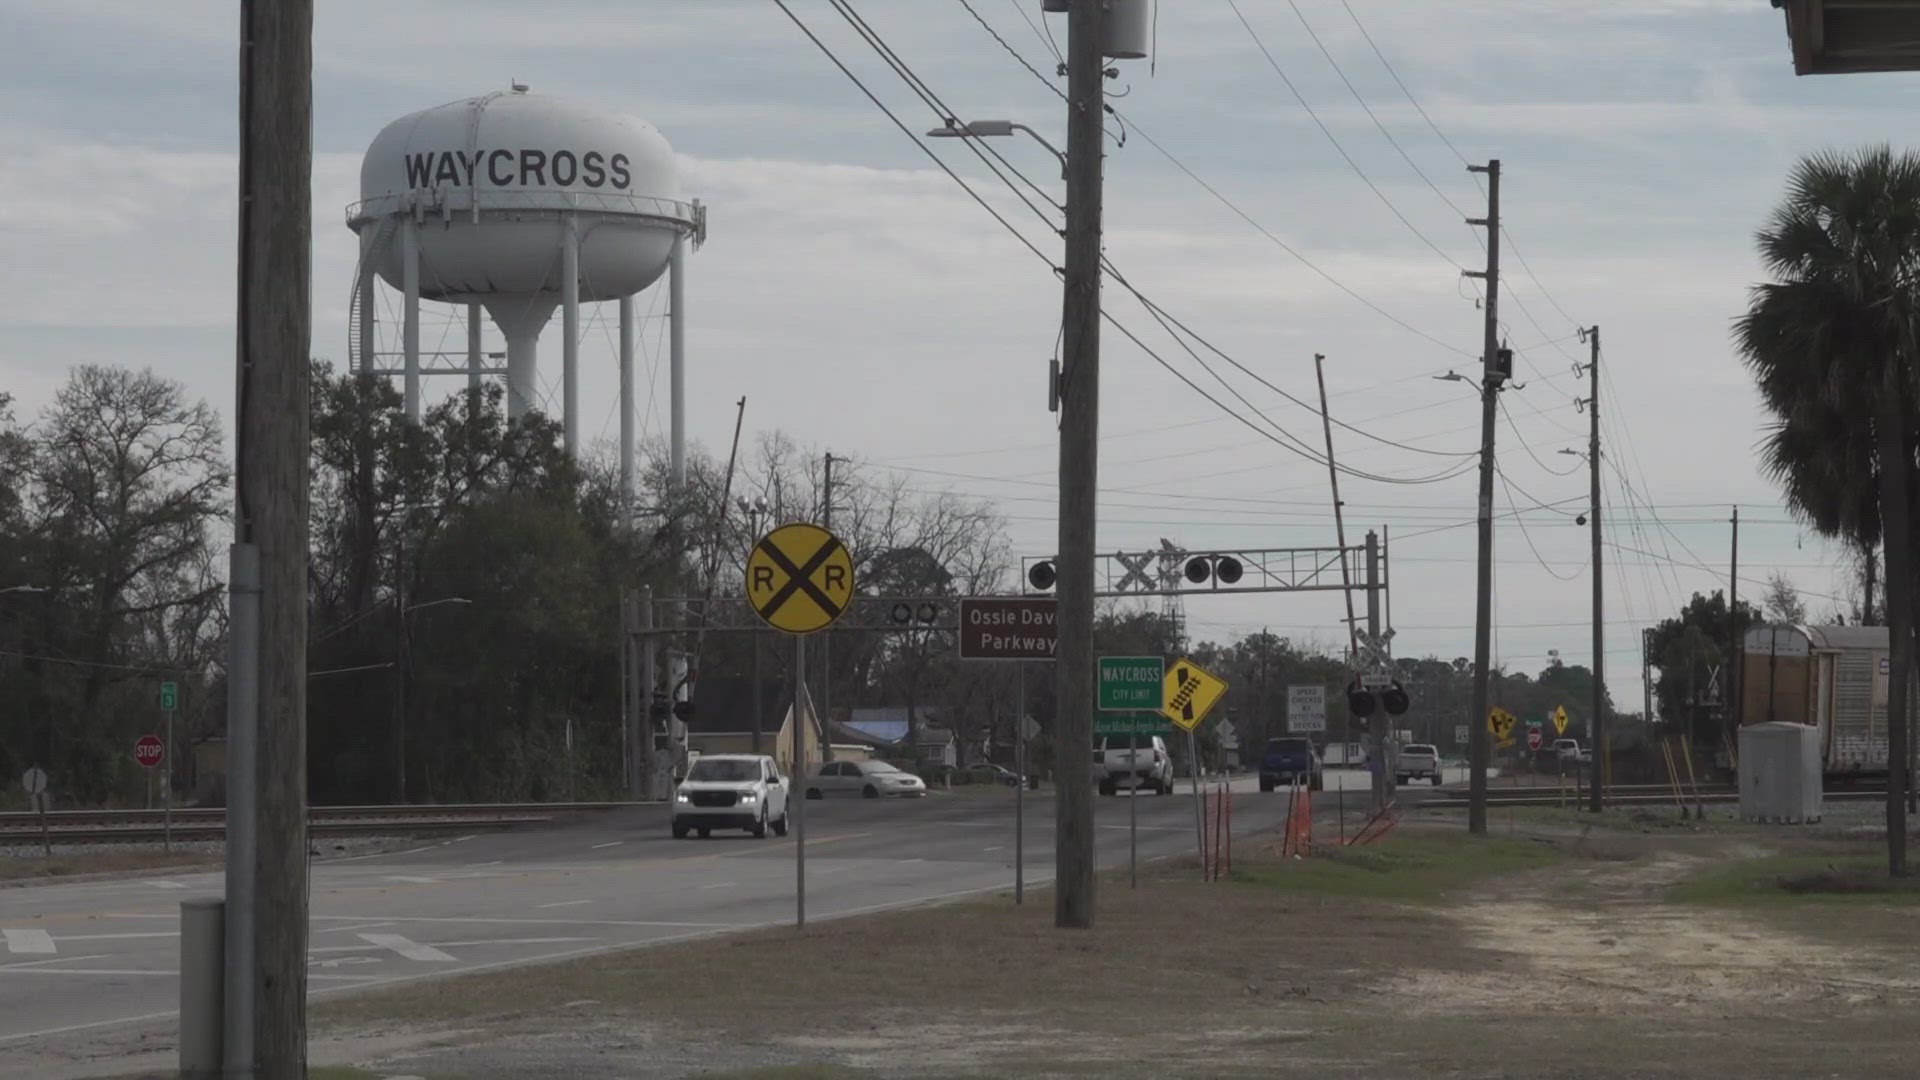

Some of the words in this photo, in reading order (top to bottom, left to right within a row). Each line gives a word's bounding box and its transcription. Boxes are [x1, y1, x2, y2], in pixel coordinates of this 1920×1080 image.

[405, 149, 630, 189] WAYCROSS
[754, 566, 774, 592] R
[825, 565, 845, 591] R
[970, 609, 1017, 625] Ossie
[1021, 609, 1059, 625] Dav
[981, 632, 1059, 655] Parkway
[1102, 667, 1160, 682] WAYCROSS
[1112, 688, 1129, 701] CITY
[1131, 688, 1151, 701] LIMIT
[1292, 696, 1322, 704] CHECKED
[137, 745, 162, 757] STOP
